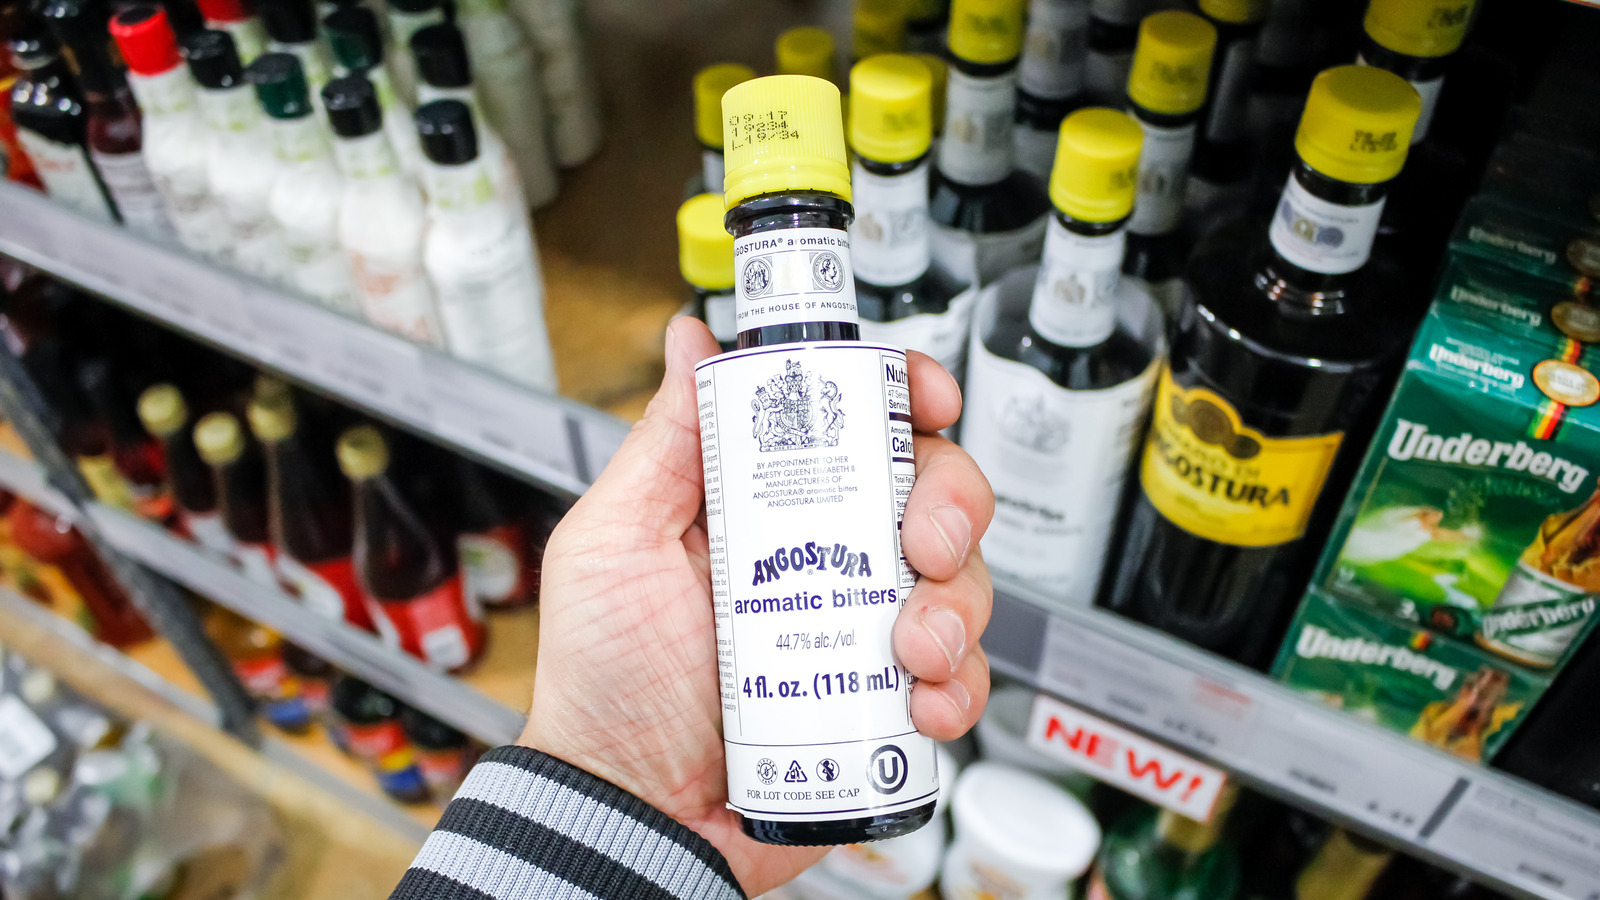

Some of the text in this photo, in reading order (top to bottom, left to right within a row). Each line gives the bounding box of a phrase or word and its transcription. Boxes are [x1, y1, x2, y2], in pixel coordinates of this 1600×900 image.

[787, 235, 835, 247] aromatic
[751, 307, 765, 315] THE
[769, 303, 800, 313] HOUSE
[1451, 284, 1542, 327] Underberg
[1429, 343, 1525, 389] Underberg
[767, 457, 820, 469] APPOINTMENT
[823, 456, 833, 464] TO
[1387, 418, 1590, 495] Underberg
[752, 470, 782, 480] MAJESTY
[784, 468, 811, 477] QUEEN
[813, 465, 849, 475] ELIZABETH
[766, 475, 842, 488] MANUFACTURERS OF
[806, 487, 837, 495] aromatic
[838, 485, 858, 493] bitters
[768, 495, 844, 508] ANGOSTURA LIMITED
[752, 541, 872, 587] ANGOSTURA
[735, 588, 897, 615] aromatic bitters
[776, 629, 857, 650] 44.7% alc./vol.
[1296, 624, 1457, 691] Underberg
[778, 680, 808, 698] oz.
[813, 671, 860, 699] (118
[866, 665, 899, 692] mL)
[1046, 716, 1204, 803] NEW!
[747, 788, 860, 801] FOR LOT CODE SEE CAP
